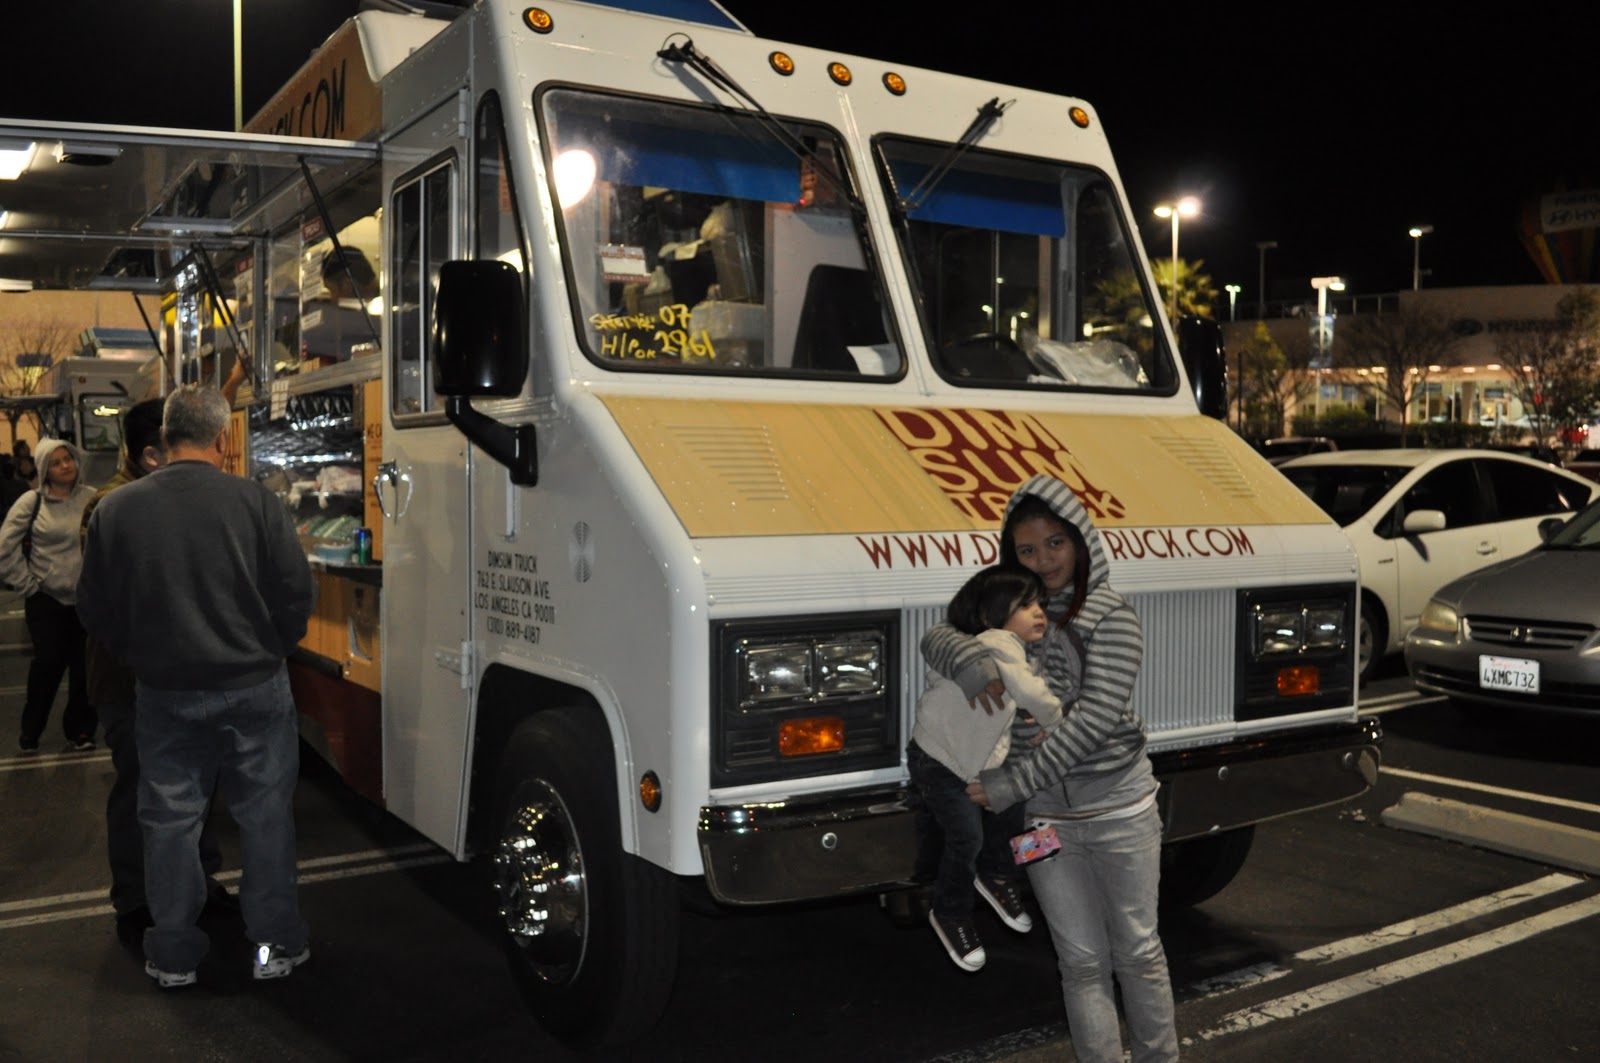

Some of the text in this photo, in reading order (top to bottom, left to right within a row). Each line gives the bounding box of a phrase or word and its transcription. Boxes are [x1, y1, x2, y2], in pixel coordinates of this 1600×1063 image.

[659, 303, 693, 329] 07
[653, 328, 716, 361] 2961
[878, 408, 1062, 450] DIM
[909, 448, 1104, 491] SUM
[943, 490, 1128, 522] TRK
[488, 550, 538, 573] DIMSUM TRUCK
[855, 526, 1255, 570] WWW.DRUCK.COM
[499, 574, 532, 596] SLAUSON
[475, 592, 489, 610] LOS
[491, 595, 519, 616] ANGELES
[522, 601, 531, 619] CA
[1483, 668, 1536, 689] 4XMC732
